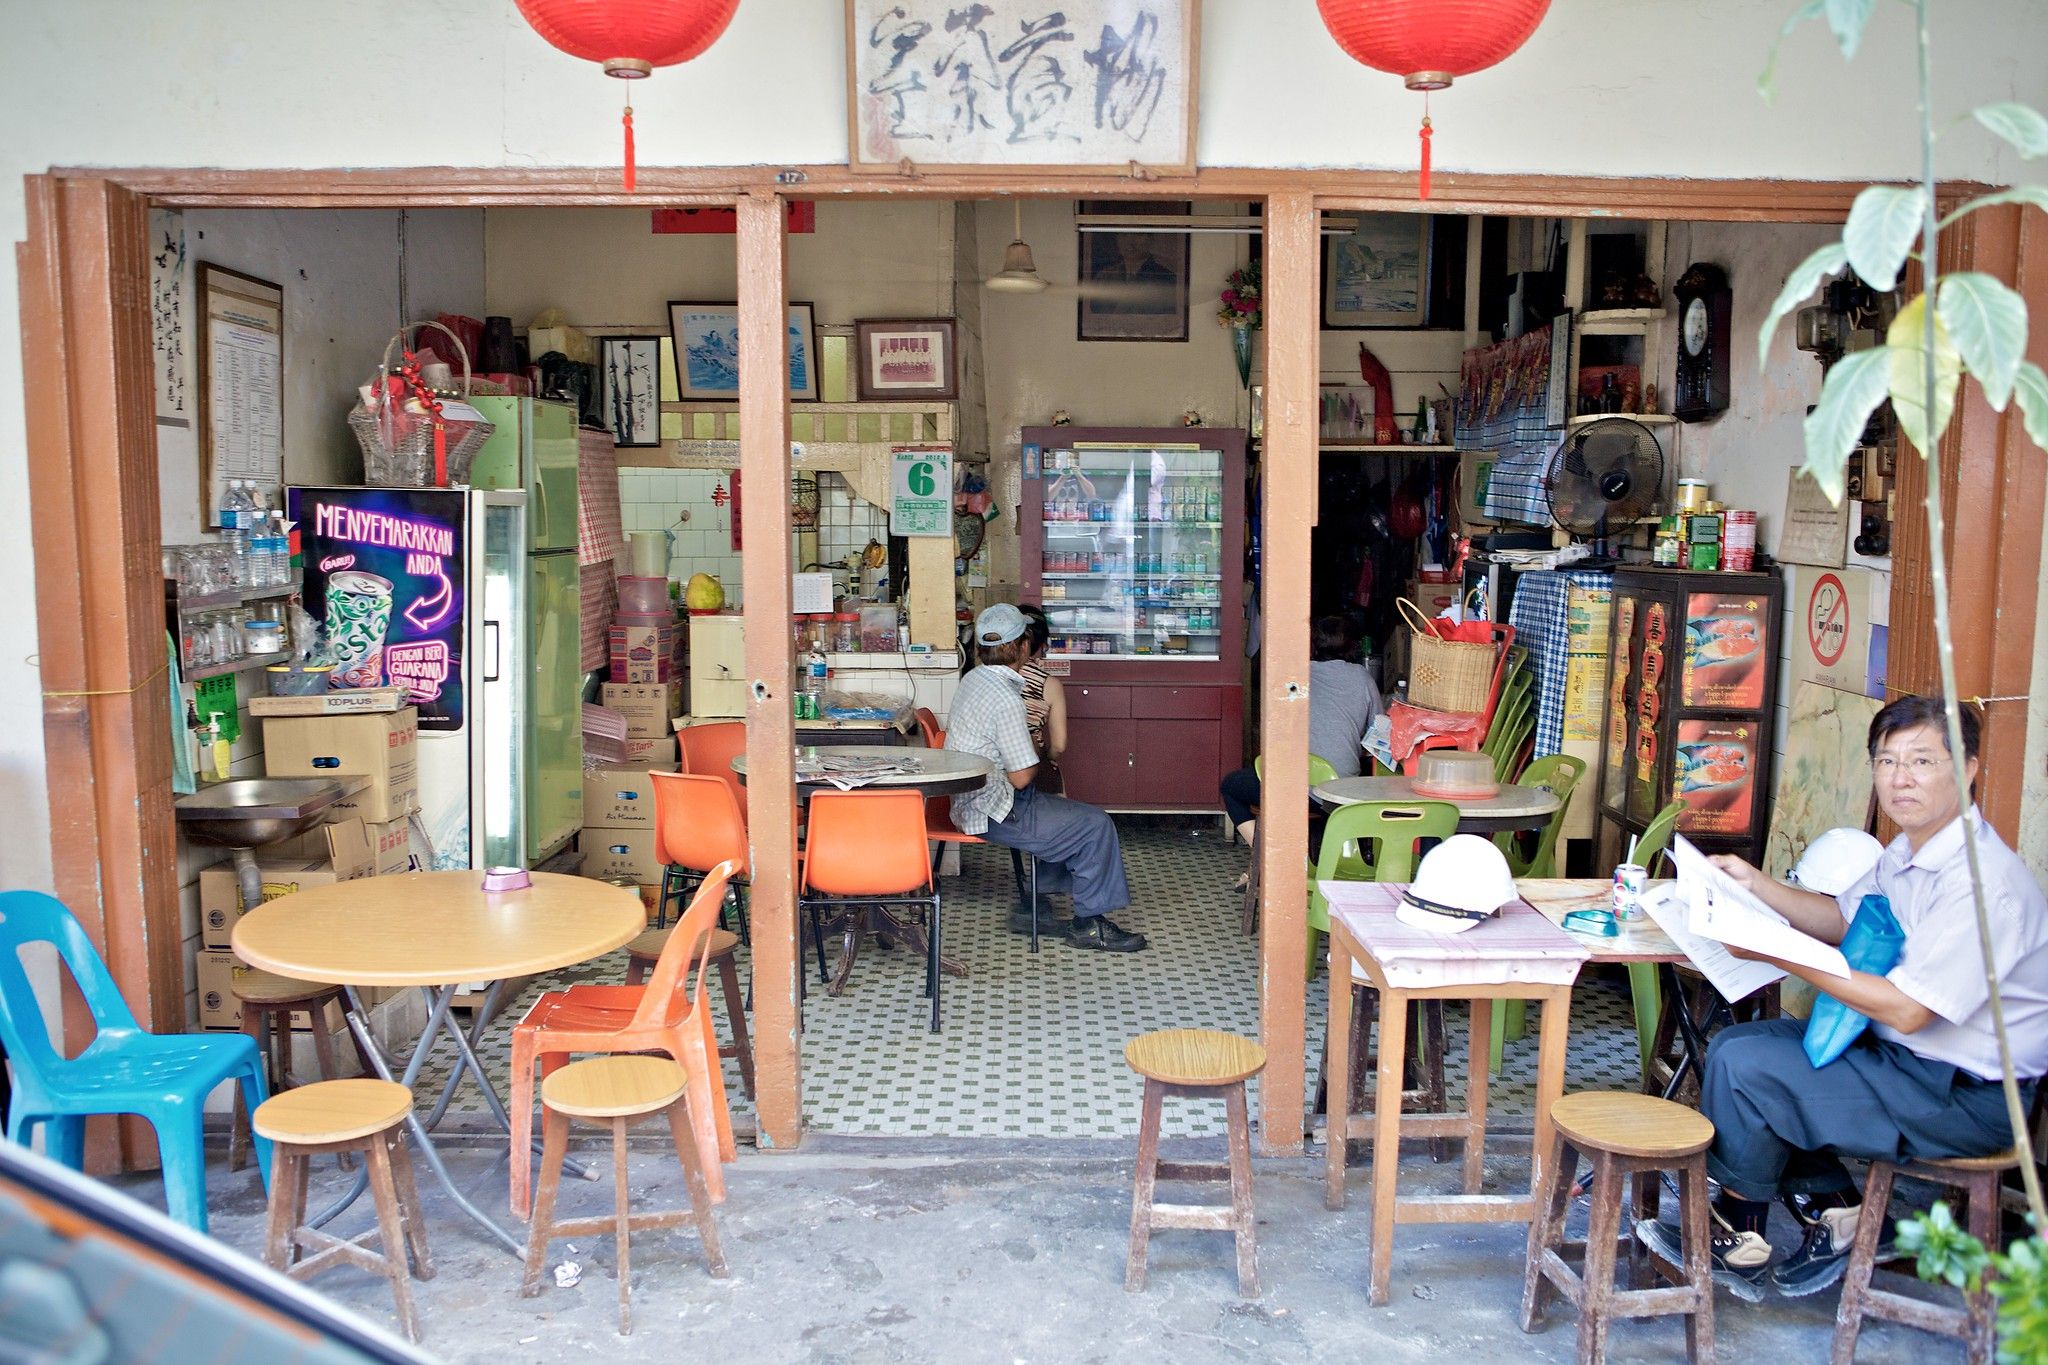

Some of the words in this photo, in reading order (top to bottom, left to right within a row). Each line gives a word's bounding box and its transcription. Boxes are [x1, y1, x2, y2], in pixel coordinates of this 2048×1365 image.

[908, 462, 936, 497] 6
[316, 503, 453, 556] MENYEMARAKKAN
[406, 554, 443, 576] ANDA
[391, 647, 424, 662] DENGAN
[391, 661, 442, 680] GUARANA
[327, 697, 373, 707] 100PLUS
